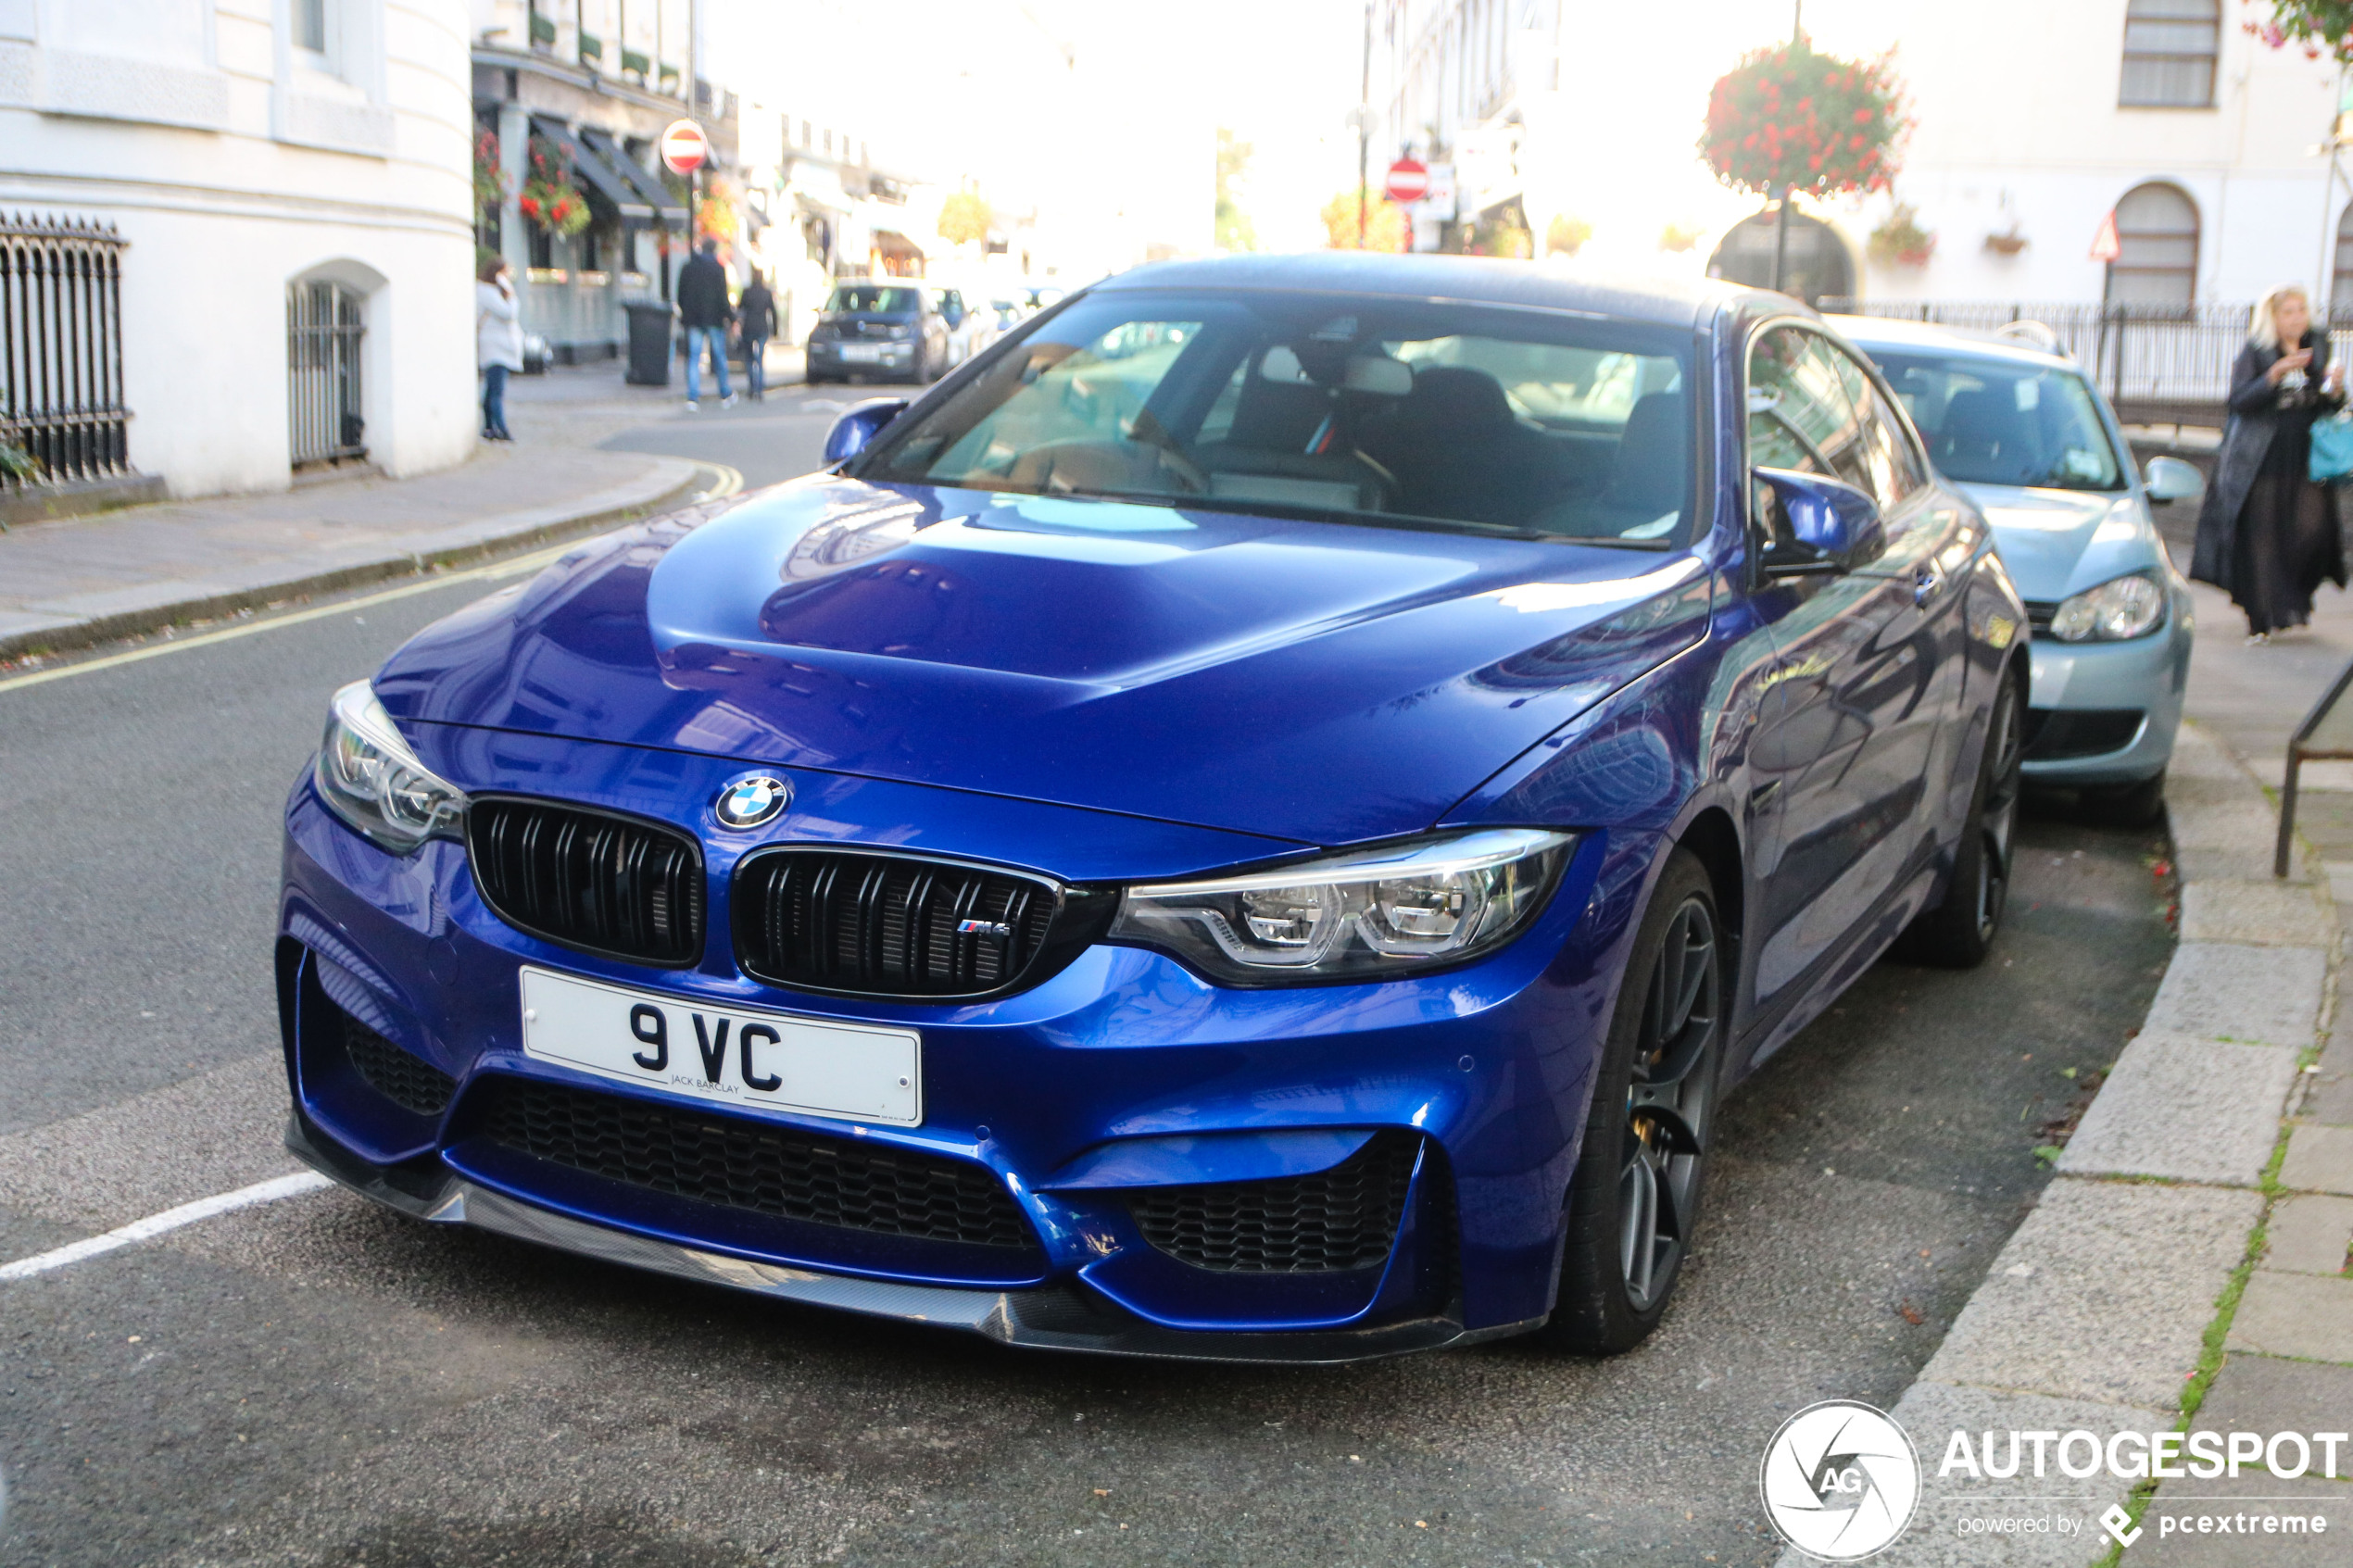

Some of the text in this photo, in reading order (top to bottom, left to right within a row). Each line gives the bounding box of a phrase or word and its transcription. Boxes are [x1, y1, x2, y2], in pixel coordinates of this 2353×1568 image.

[630, 1003, 783, 1092] 9 VC
[671, 1073, 694, 1087] JACK
[697, 1079, 739, 1095] BARCLAY
